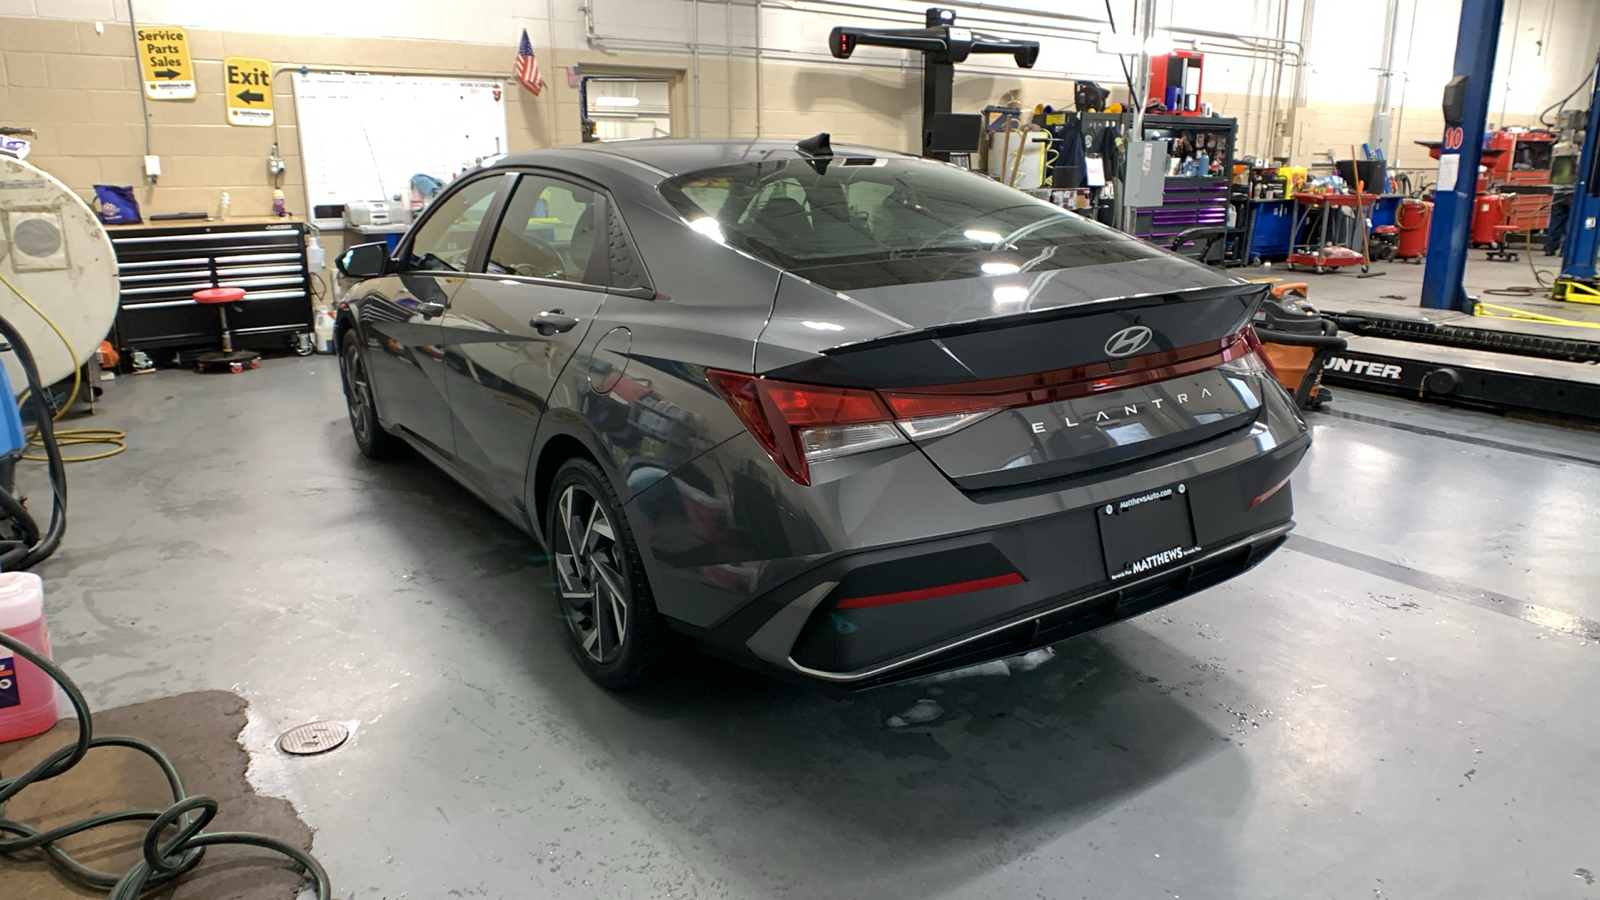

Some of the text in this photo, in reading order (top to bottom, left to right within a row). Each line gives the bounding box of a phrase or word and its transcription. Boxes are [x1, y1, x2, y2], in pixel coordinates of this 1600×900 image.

[138, 30, 183, 41] Service
[147, 43, 179, 54] Parts
[150, 57, 181, 67] Sales
[227, 65, 270, 87] Exit
[1445, 127, 1463, 149] 10
[1323, 356, 1402, 379] UNTER
[1032, 388, 1212, 434] ELANTRA
[1120, 488, 1172, 508] MatthewsAuto.com
[1132, 547, 1183, 574] MATTHEWS
